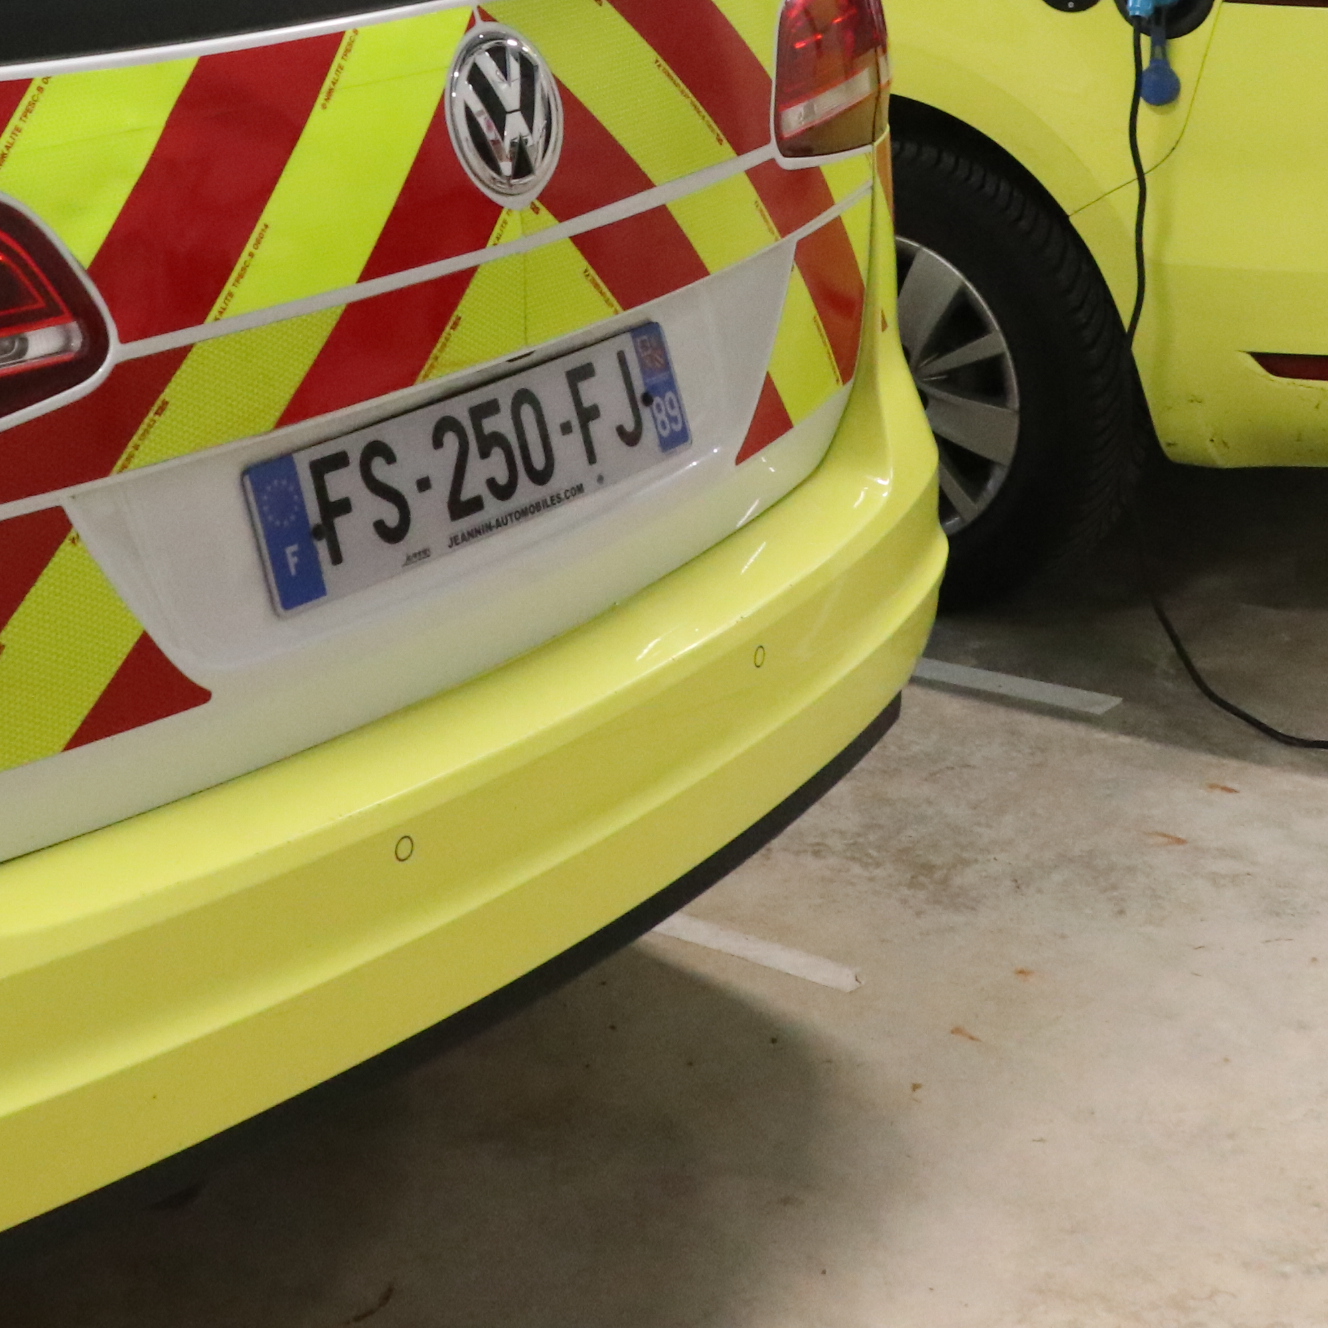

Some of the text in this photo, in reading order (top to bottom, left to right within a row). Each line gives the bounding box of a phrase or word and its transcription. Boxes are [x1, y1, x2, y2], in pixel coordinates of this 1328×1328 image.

[308, 350, 645, 566] FS-250-FJ
[652, 391, 683, 438] 89
[448, 483, 585, 549] JEANNIN-AUTOMOBILES.COM
[285, 545, 299, 577] F
